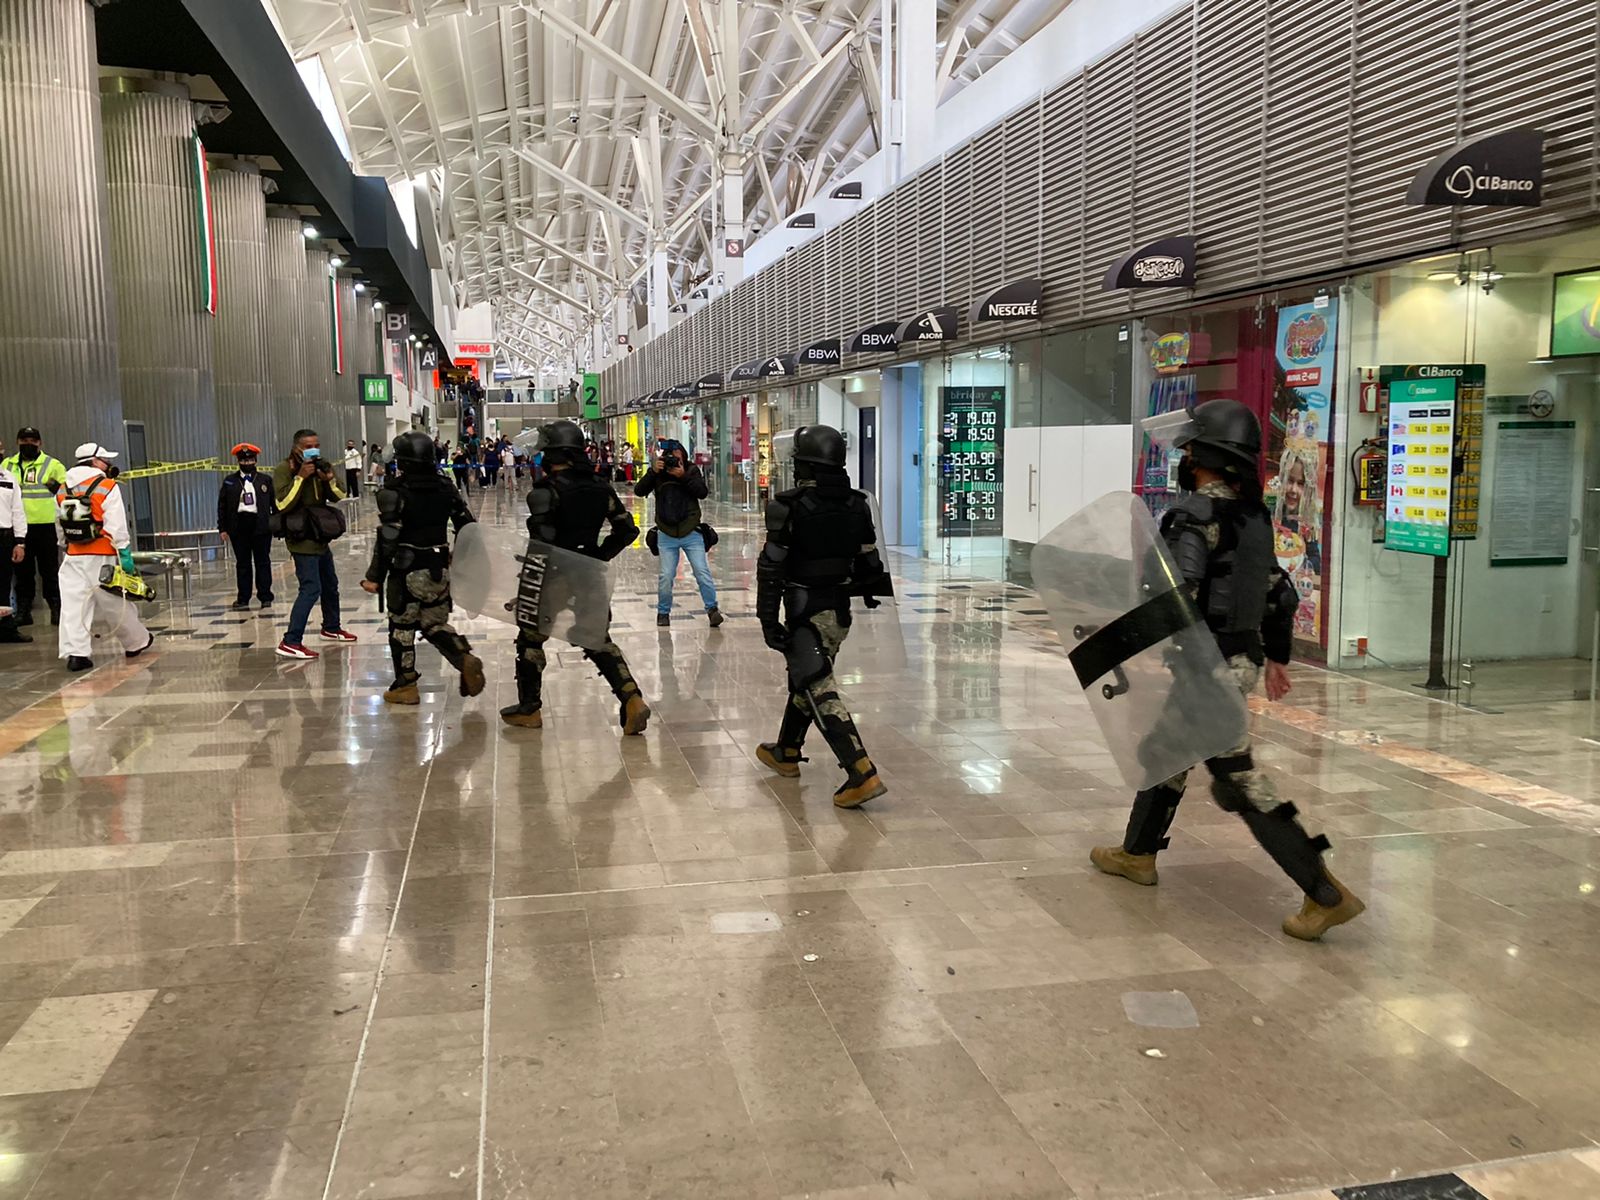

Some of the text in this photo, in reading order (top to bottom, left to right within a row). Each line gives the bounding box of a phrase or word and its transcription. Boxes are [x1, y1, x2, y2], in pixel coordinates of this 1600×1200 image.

[1475, 176, 1534, 191] CIBanco
[988, 300, 1038, 317] NESCAFÉ
[861, 334, 897, 346] BBVA
[918, 332, 944, 340] AICM
[458, 344, 491, 353] WINGS
[808, 349, 839, 359] BBVA
[1418, 366, 1464, 377] CIBanco
[585, 386, 598, 406] 2
[966, 411, 997, 425] 19.00
[967, 427, 995, 441] 19.50
[963, 452, 995, 465] 20.90
[963, 468, 996, 481] 21.15
[966, 491, 995, 505] 16.30
[966, 507, 995, 520] 16.70
[517, 553, 549, 627] POLICIA
